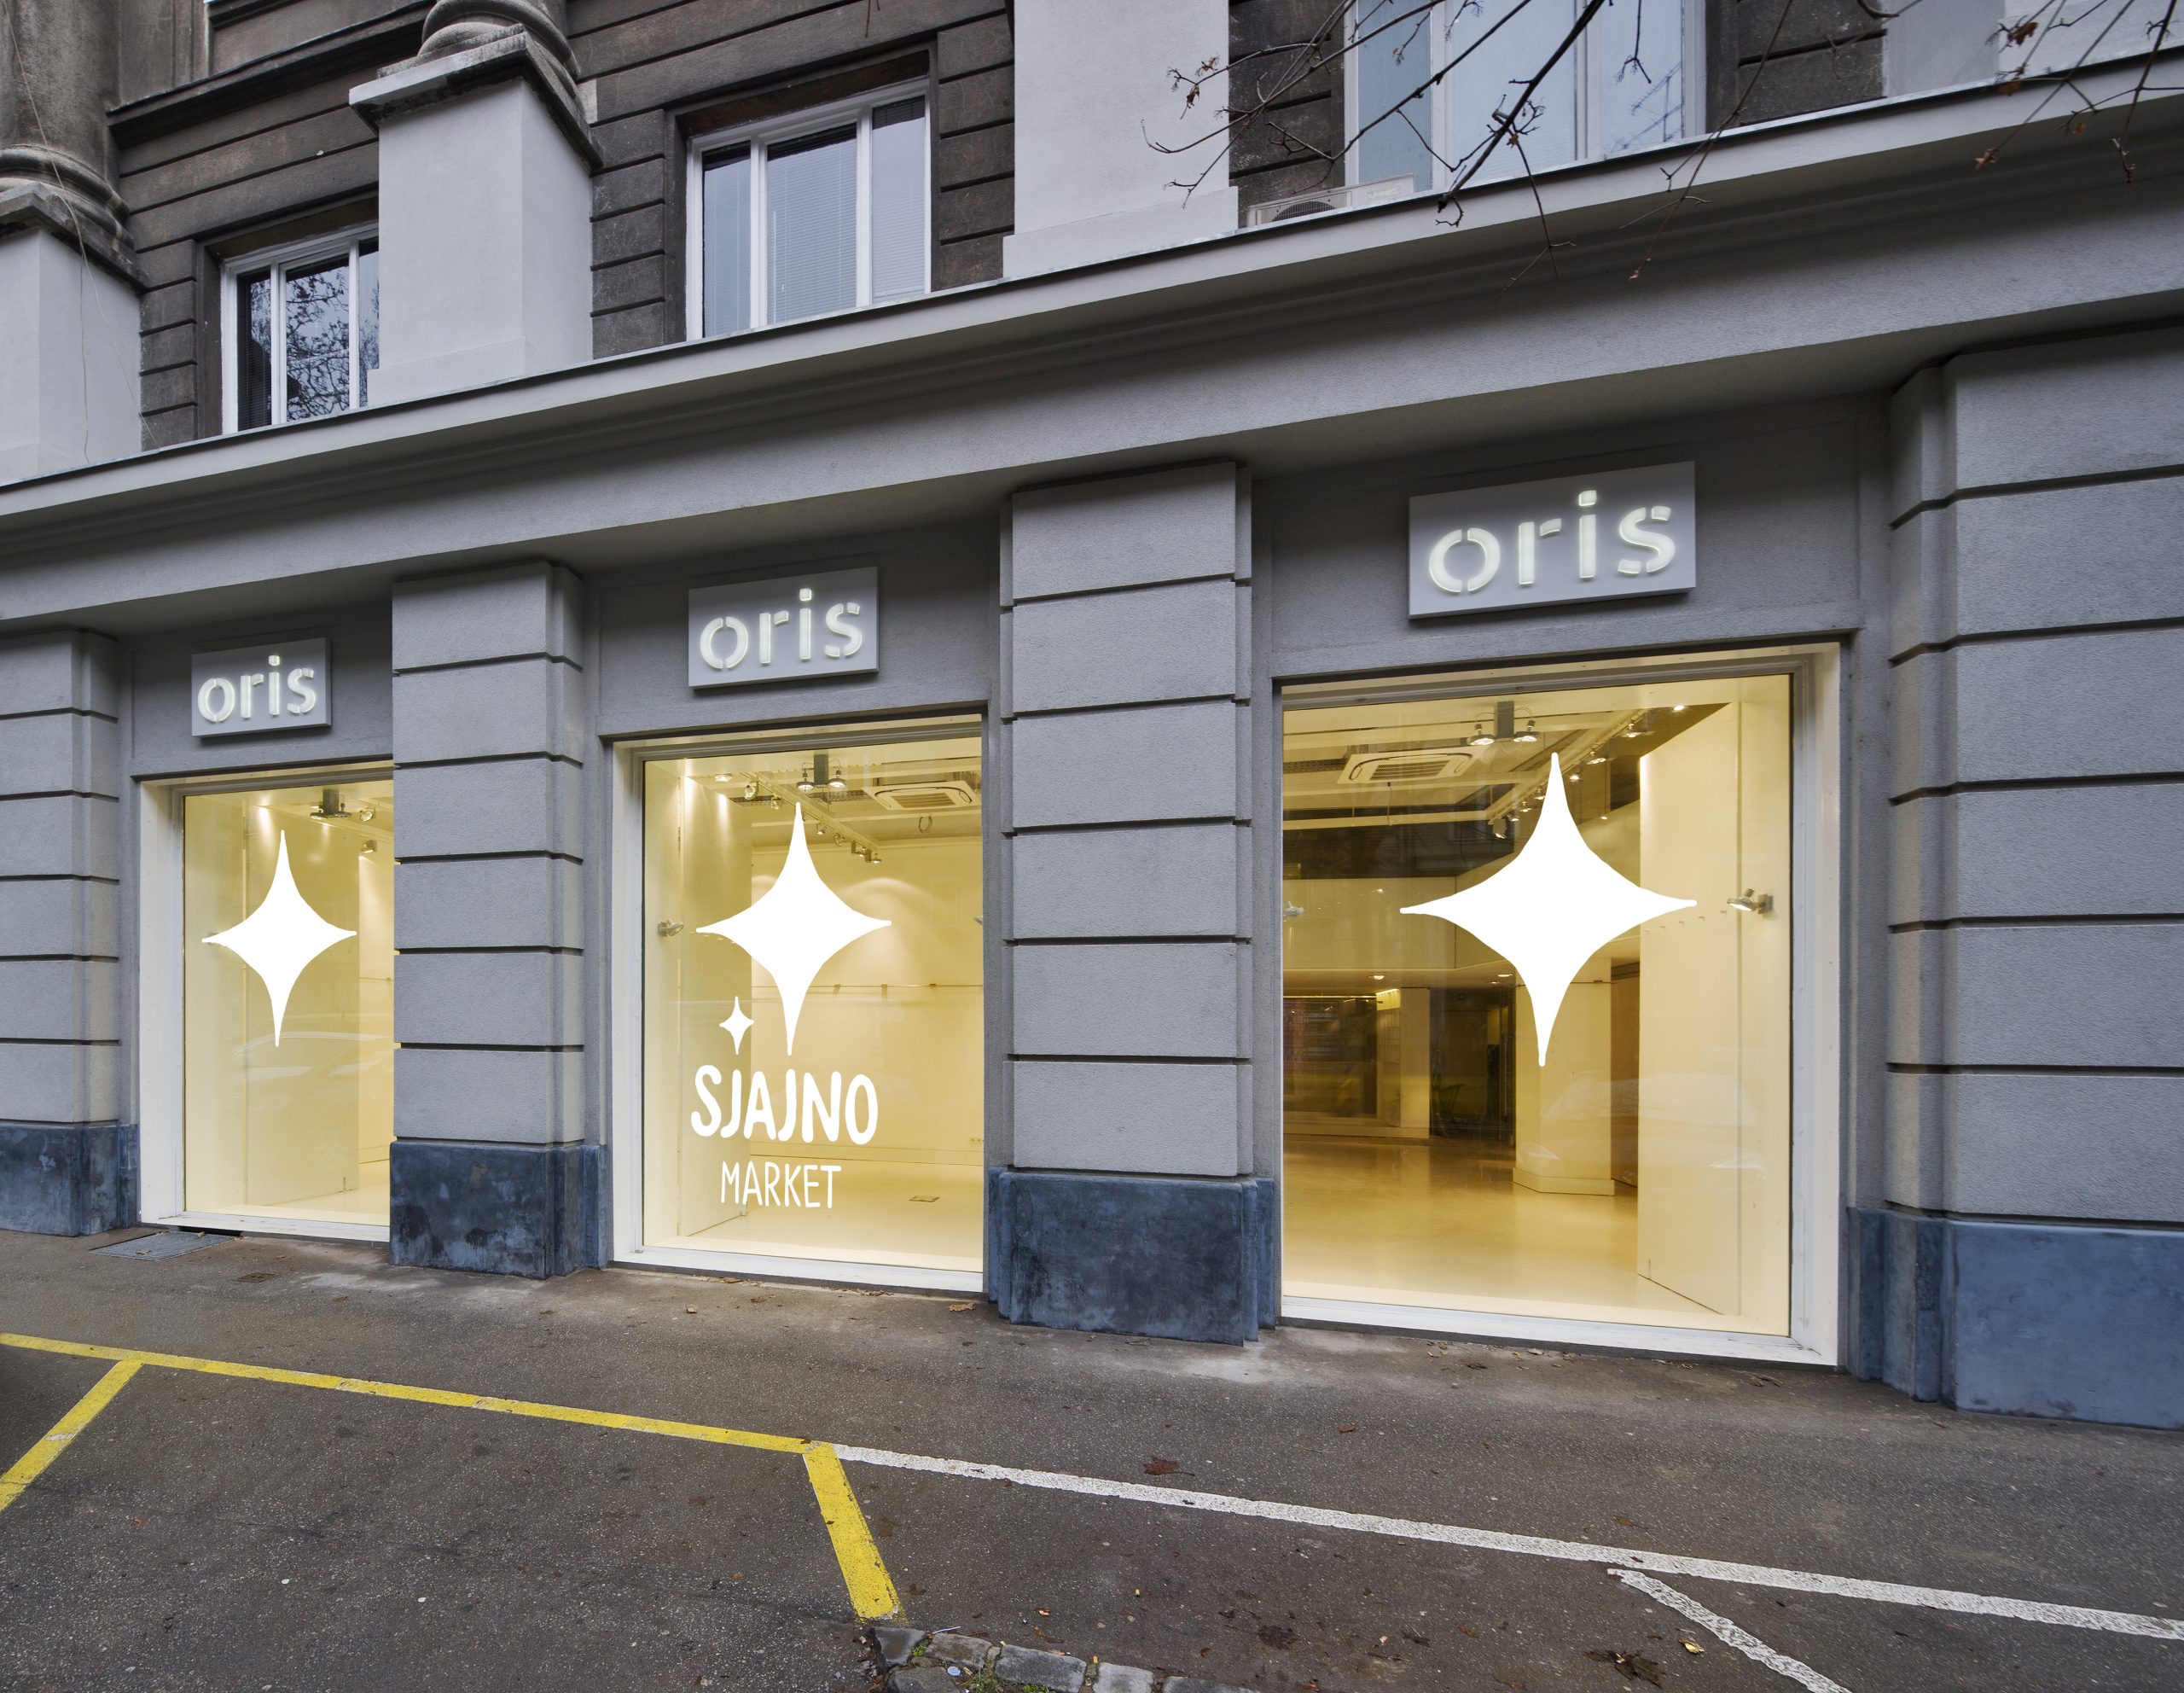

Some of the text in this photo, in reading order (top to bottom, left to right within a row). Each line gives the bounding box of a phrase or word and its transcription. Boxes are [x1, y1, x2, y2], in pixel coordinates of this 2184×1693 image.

[1428, 490, 1676, 594] oris
[700, 588, 863, 670] oris
[198, 655, 317, 723] oris
[690, 1064, 879, 1145] SJAJNO
[721, 1161, 842, 1208] MARKET
